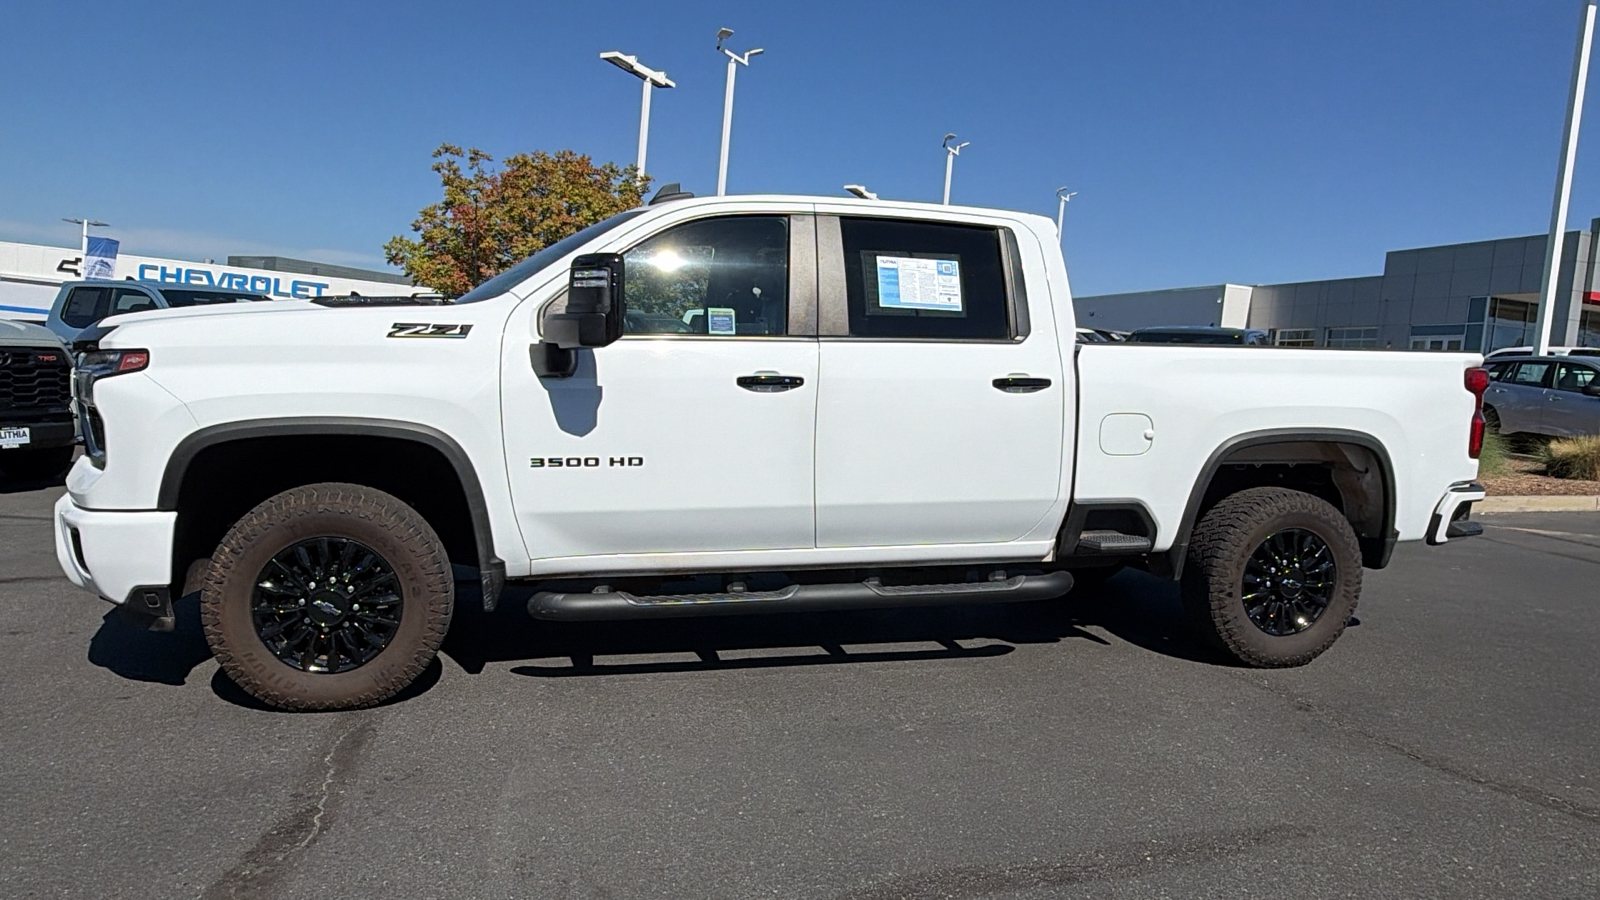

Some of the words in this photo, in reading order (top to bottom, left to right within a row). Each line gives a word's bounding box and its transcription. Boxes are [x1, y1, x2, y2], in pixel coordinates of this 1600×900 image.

[139, 263, 329, 299] CHEVROLET
[0, 430, 28, 439] LITHIA
[530, 457, 600, 468] 3500
[609, 457, 644, 467] HD
